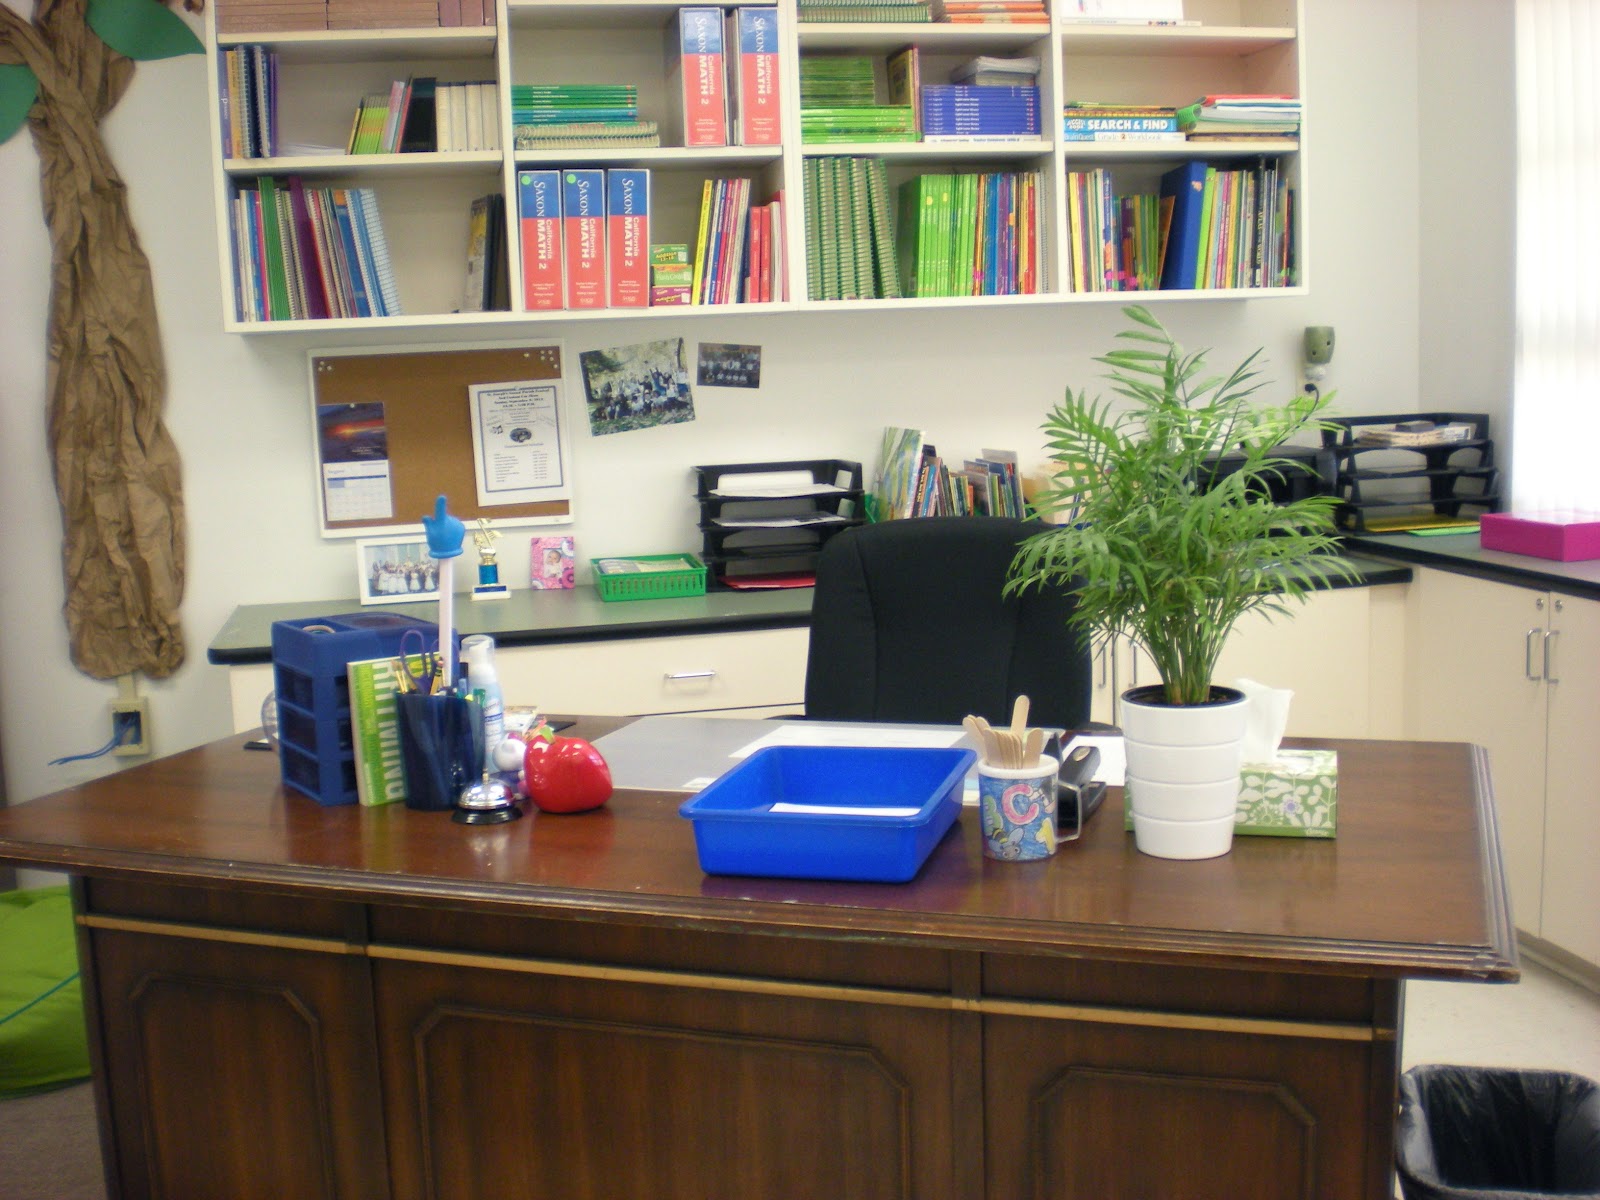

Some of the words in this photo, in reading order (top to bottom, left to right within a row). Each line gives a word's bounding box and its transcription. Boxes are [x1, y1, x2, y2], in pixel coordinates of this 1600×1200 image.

[694, 16, 707, 53] SAXON
[753, 16, 765, 52] SAXON
[698, 54, 710, 95] MATH
[707, 55, 716, 96] California
[756, 54, 767, 95] MATH
[764, 55, 772, 95] California
[1087, 119, 1132, 130] SEARCH
[1133, 120, 1141, 130] &
[1142, 119, 1168, 130] FIND
[533, 180, 546, 217] SAXON
[577, 179, 590, 216] SAXON
[621, 178, 634, 214] SAXON
[536, 219, 547, 260] MATH
[545, 219, 554, 259] California
[580, 218, 590, 259] MATH
[624, 216, 633, 257] MATH
[581, 261, 590, 269] 2
[1002, 783, 1040, 826] C
